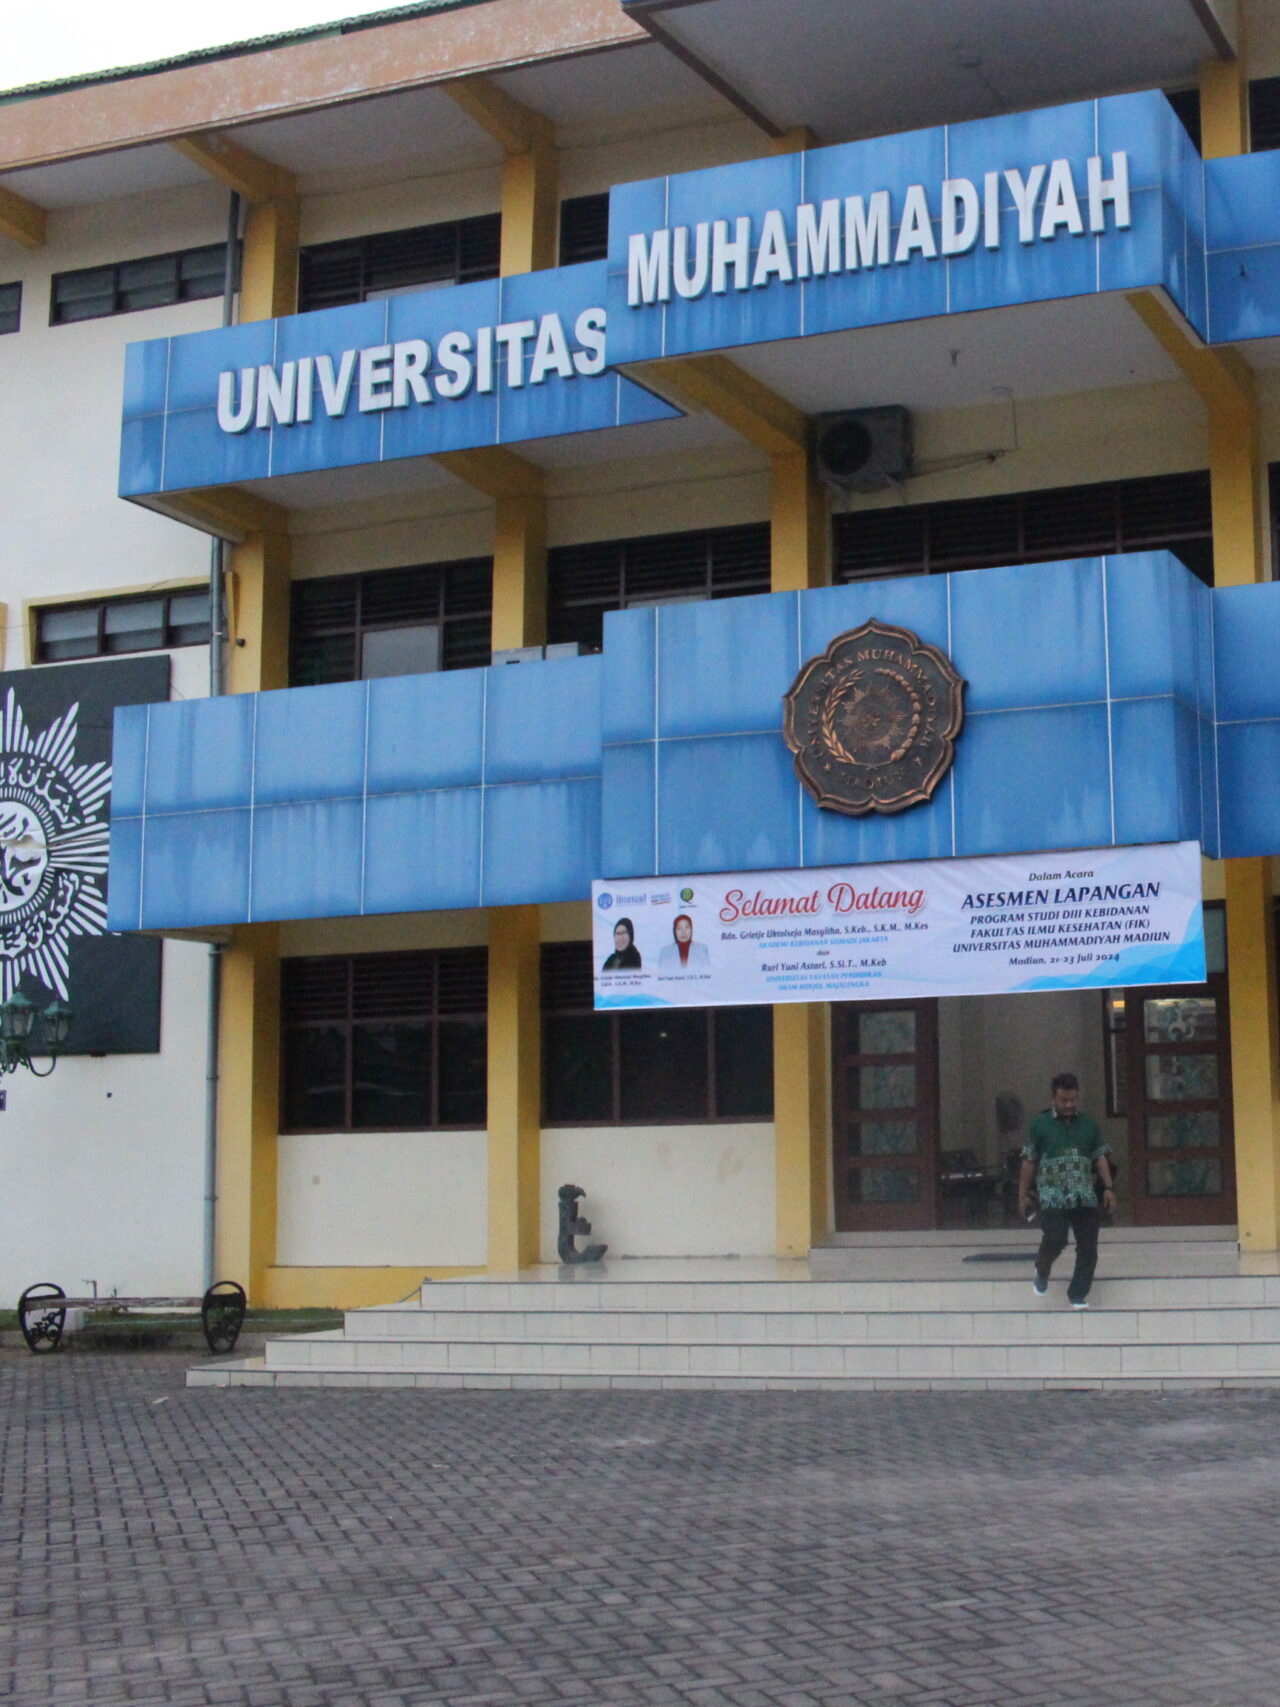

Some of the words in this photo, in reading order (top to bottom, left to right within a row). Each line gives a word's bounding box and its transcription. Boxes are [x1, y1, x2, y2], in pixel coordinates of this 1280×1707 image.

[627, 152, 1130, 308] MUHAMMADIYAH
[218, 306, 607, 434] UNIVERSITAS
[1028, 872, 1061, 882] Dalam
[1064, 870, 1094, 880] Acara
[719, 889, 820, 922] Selamat
[828, 882, 924, 914] Datang
[962, 889, 1049, 909] ASESMEN
[1054, 882, 1160, 904] LAPANGAN
[970, 912, 1025, 925] PROGRAM
[1028, 910, 1060, 922] STUDI
[1063, 909, 1082, 920] DIII
[1085, 905, 1150, 919] KEBIDANAN
[740, 930, 765, 941] Grietje
[905, 922, 929, 931] M.Kes
[970, 926, 1025, 938] FAKULTAS
[1027, 923, 1056, 935] ILMU
[1059, 921, 1122, 934] KESEHATAN
[1124, 919, 1150, 931] (FIK)
[953, 939, 1022, 953] UNIVERSITAS
[1024, 935, 1120, 949] MUHAMMADIYAH
[1123, 931, 1171, 943] MADIUN
[761, 962, 779, 972] Ruri
[780, 961, 799, 971] Yuni
[860, 958, 887, 968] M.Keb
[1009, 956, 1047, 966] Madiun,
[1077, 953, 1093, 963] Juli
[1095, 953, 1120, 962] 2024
